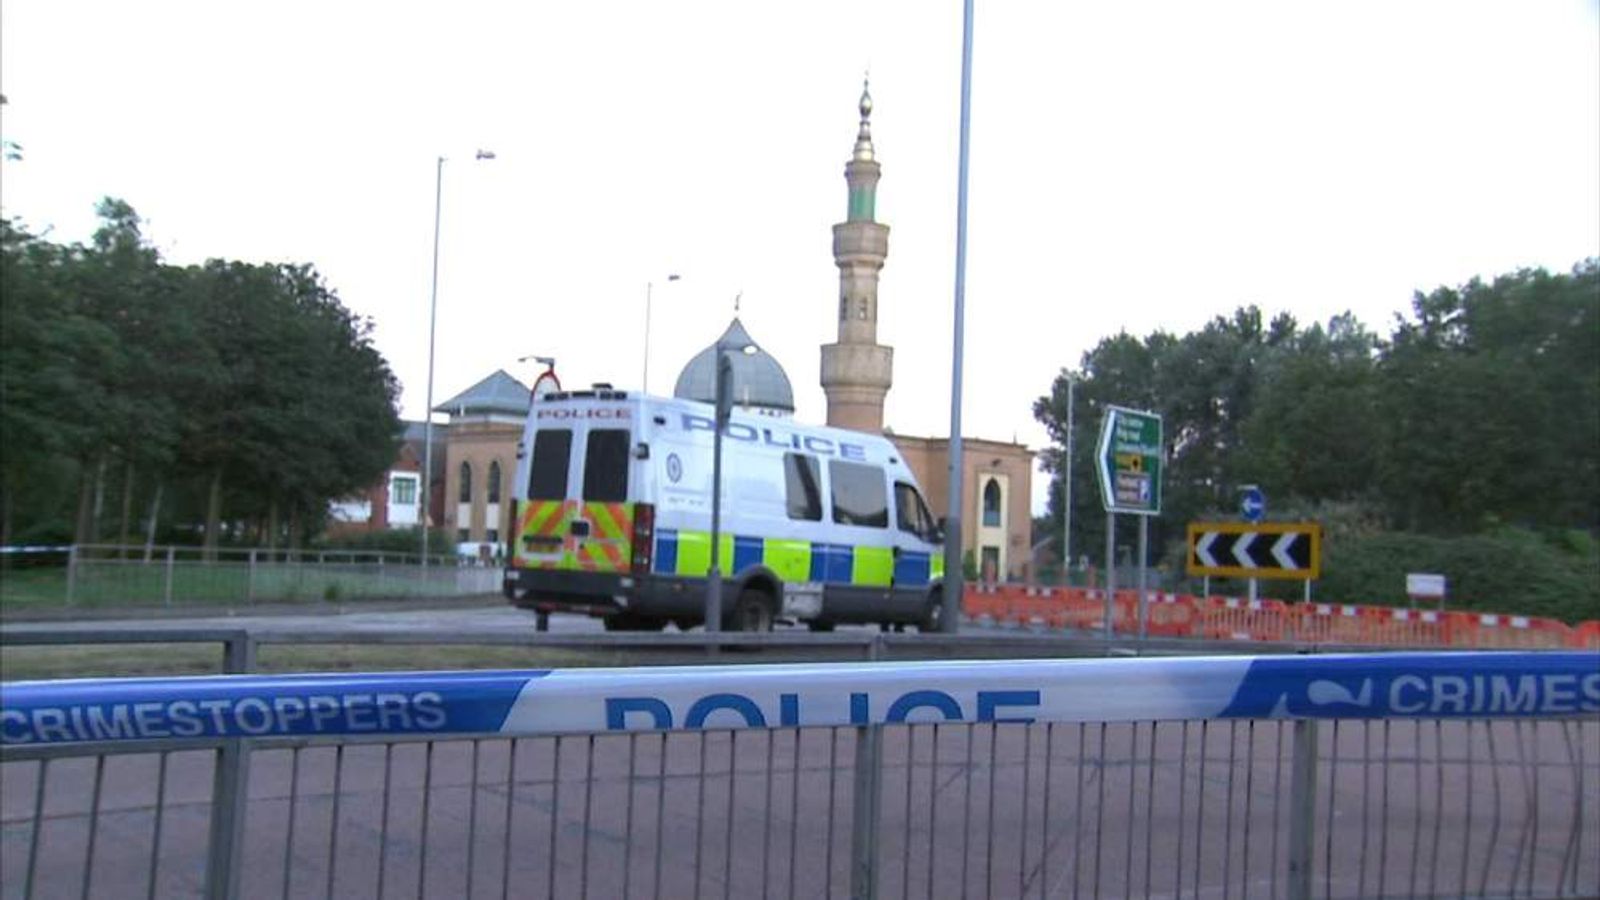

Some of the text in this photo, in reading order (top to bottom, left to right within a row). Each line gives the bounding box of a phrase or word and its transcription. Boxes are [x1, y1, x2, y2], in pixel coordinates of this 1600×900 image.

[537, 408, 631, 420] POLICE
[681, 414, 866, 460] POLICE
[0, 690, 446, 743] CRIMESTOPPERS
